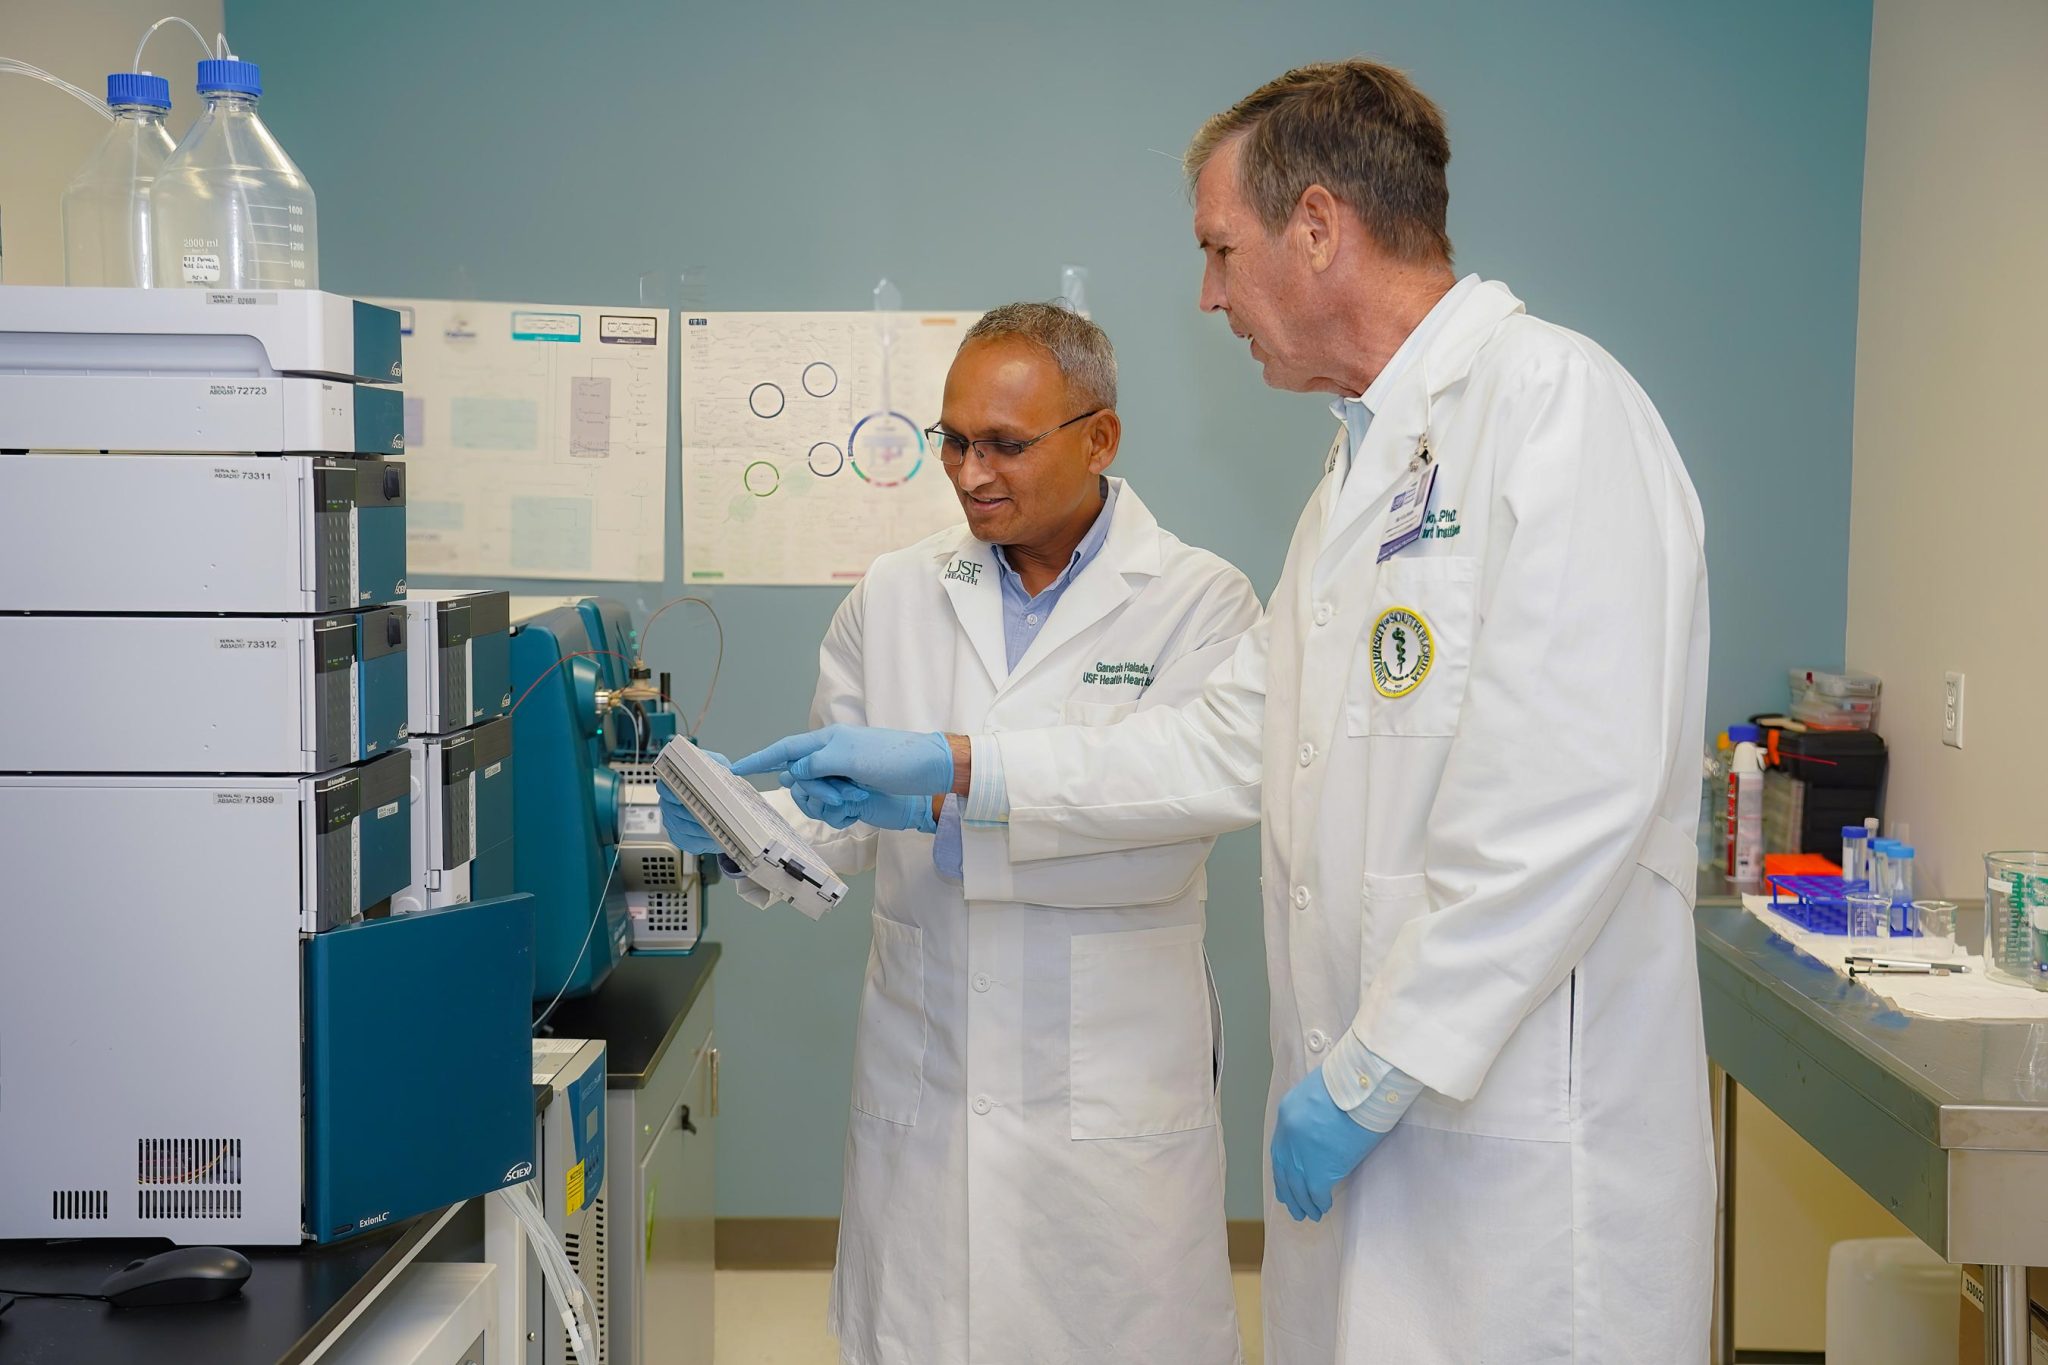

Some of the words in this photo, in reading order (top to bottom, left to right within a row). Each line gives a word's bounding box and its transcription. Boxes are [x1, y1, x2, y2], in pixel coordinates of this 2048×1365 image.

[236, 387, 267, 395] 72723
[242, 472, 271, 480] 73311
[947, 559, 983, 577] USF
[944, 571, 978, 586] HEALTH
[247, 640, 277, 649] 73312
[1096, 661, 1123, 673] Ganesh
[1083, 672, 1098, 684] USF
[1099, 674, 1122, 685] Health
[1123, 673, 1145, 687] Heart
[245, 796, 274, 804] 71389
[504, 1167, 530, 1182] SCIEX
